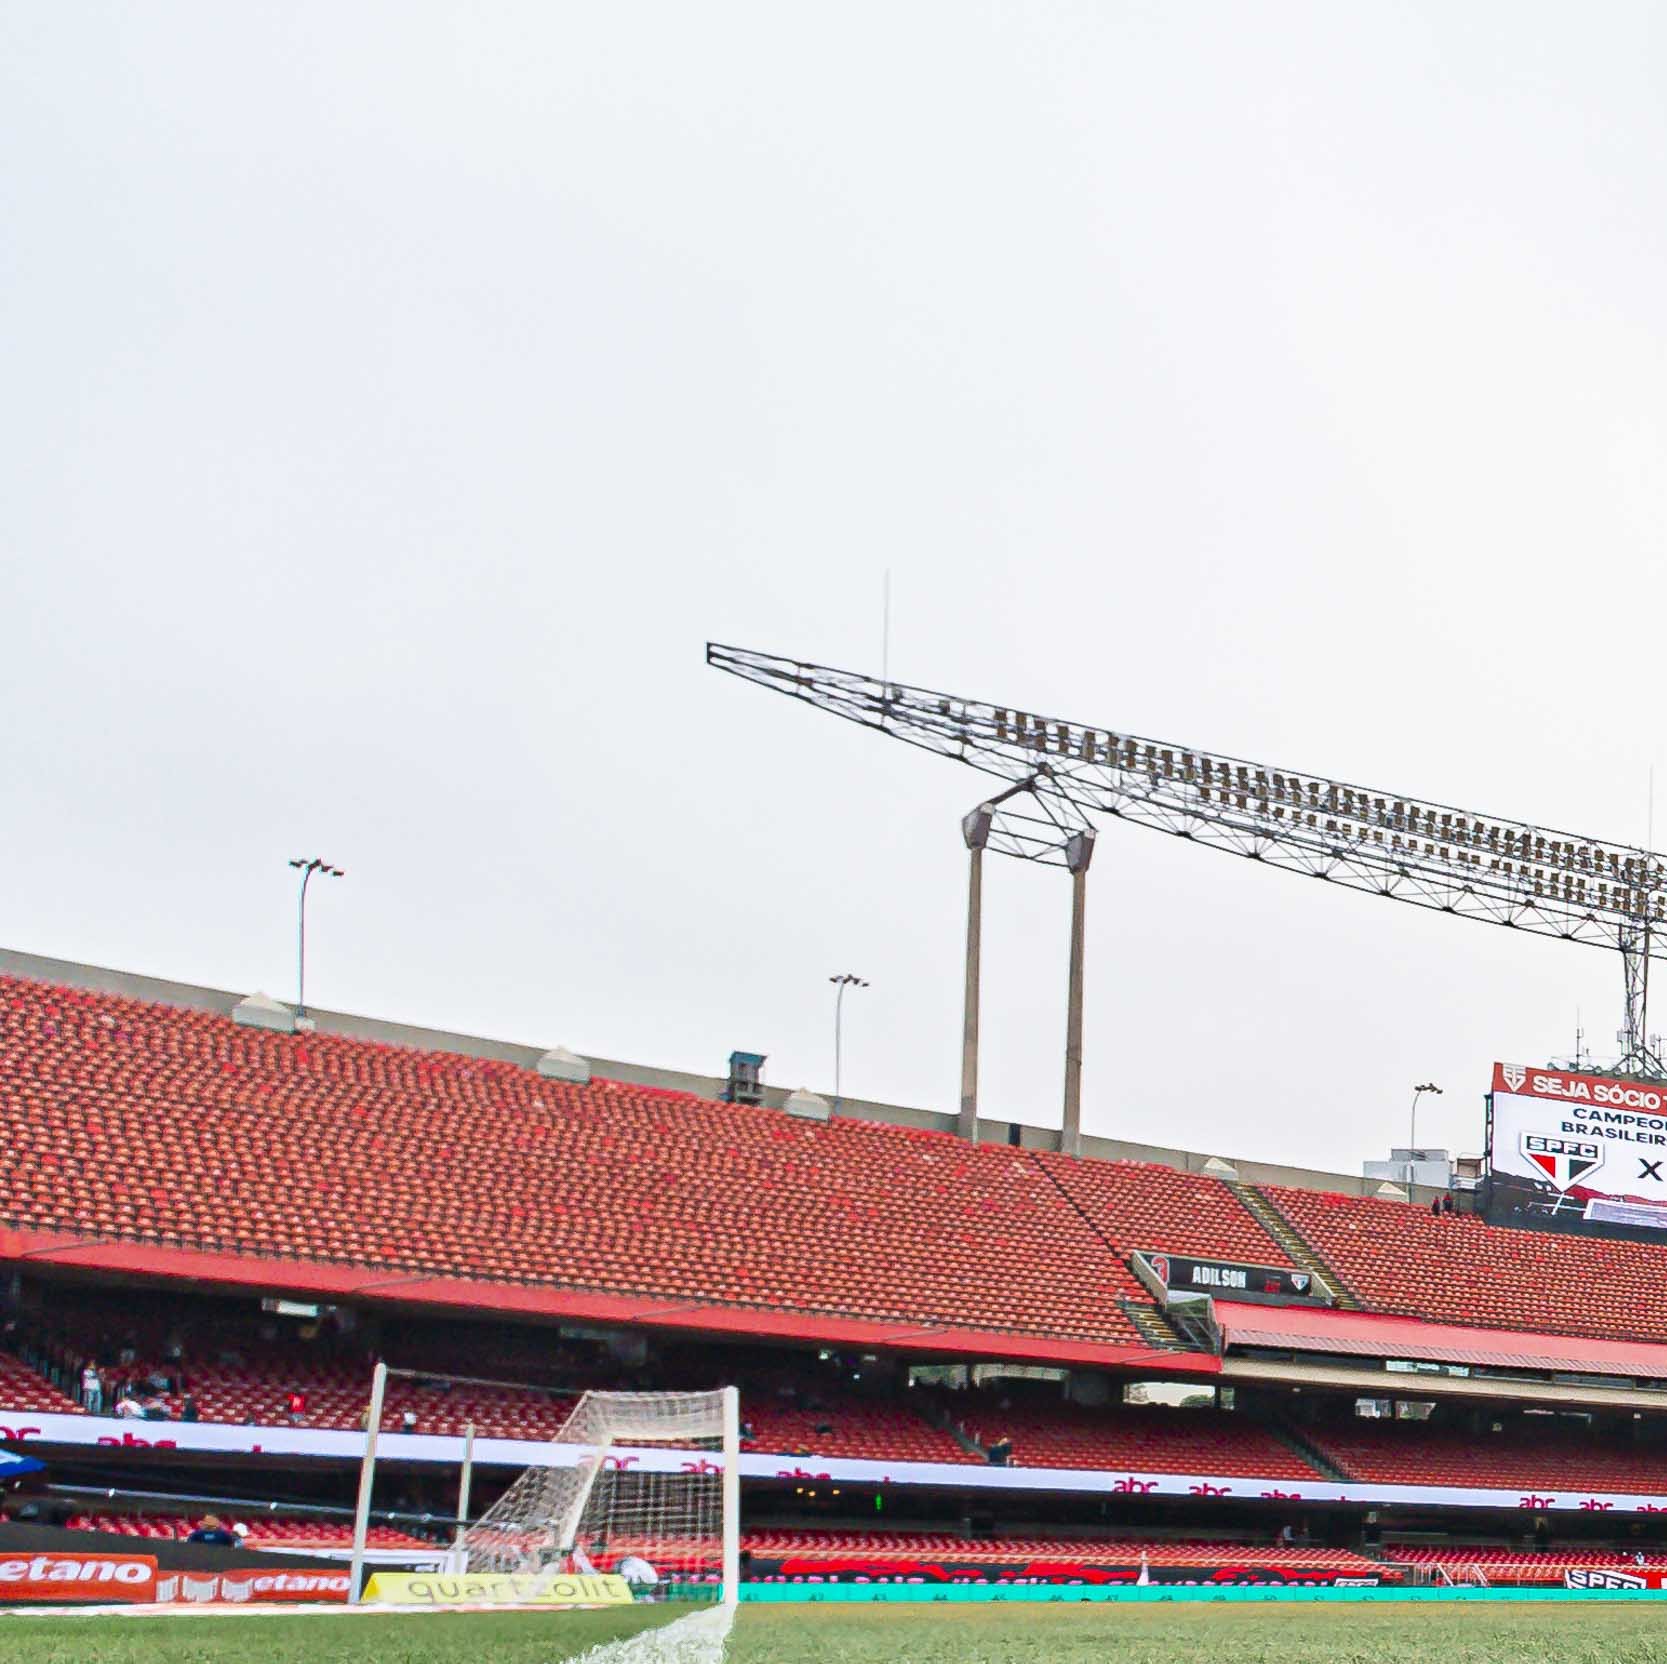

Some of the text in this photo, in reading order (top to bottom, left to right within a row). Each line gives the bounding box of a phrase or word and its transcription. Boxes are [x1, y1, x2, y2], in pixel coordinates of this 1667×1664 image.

[1533, 1075, 1590, 1099] SEJA
[1594, 1083, 1660, 1110] SÓCIO
[1528, 1137, 1597, 1157] SPFC
[1637, 1158, 1664, 1181] X
[1192, 1266, 1247, 1288] ADILSON
[1113, 1477, 1159, 1494] abc
[1519, 1495, 1555, 1509] abc
